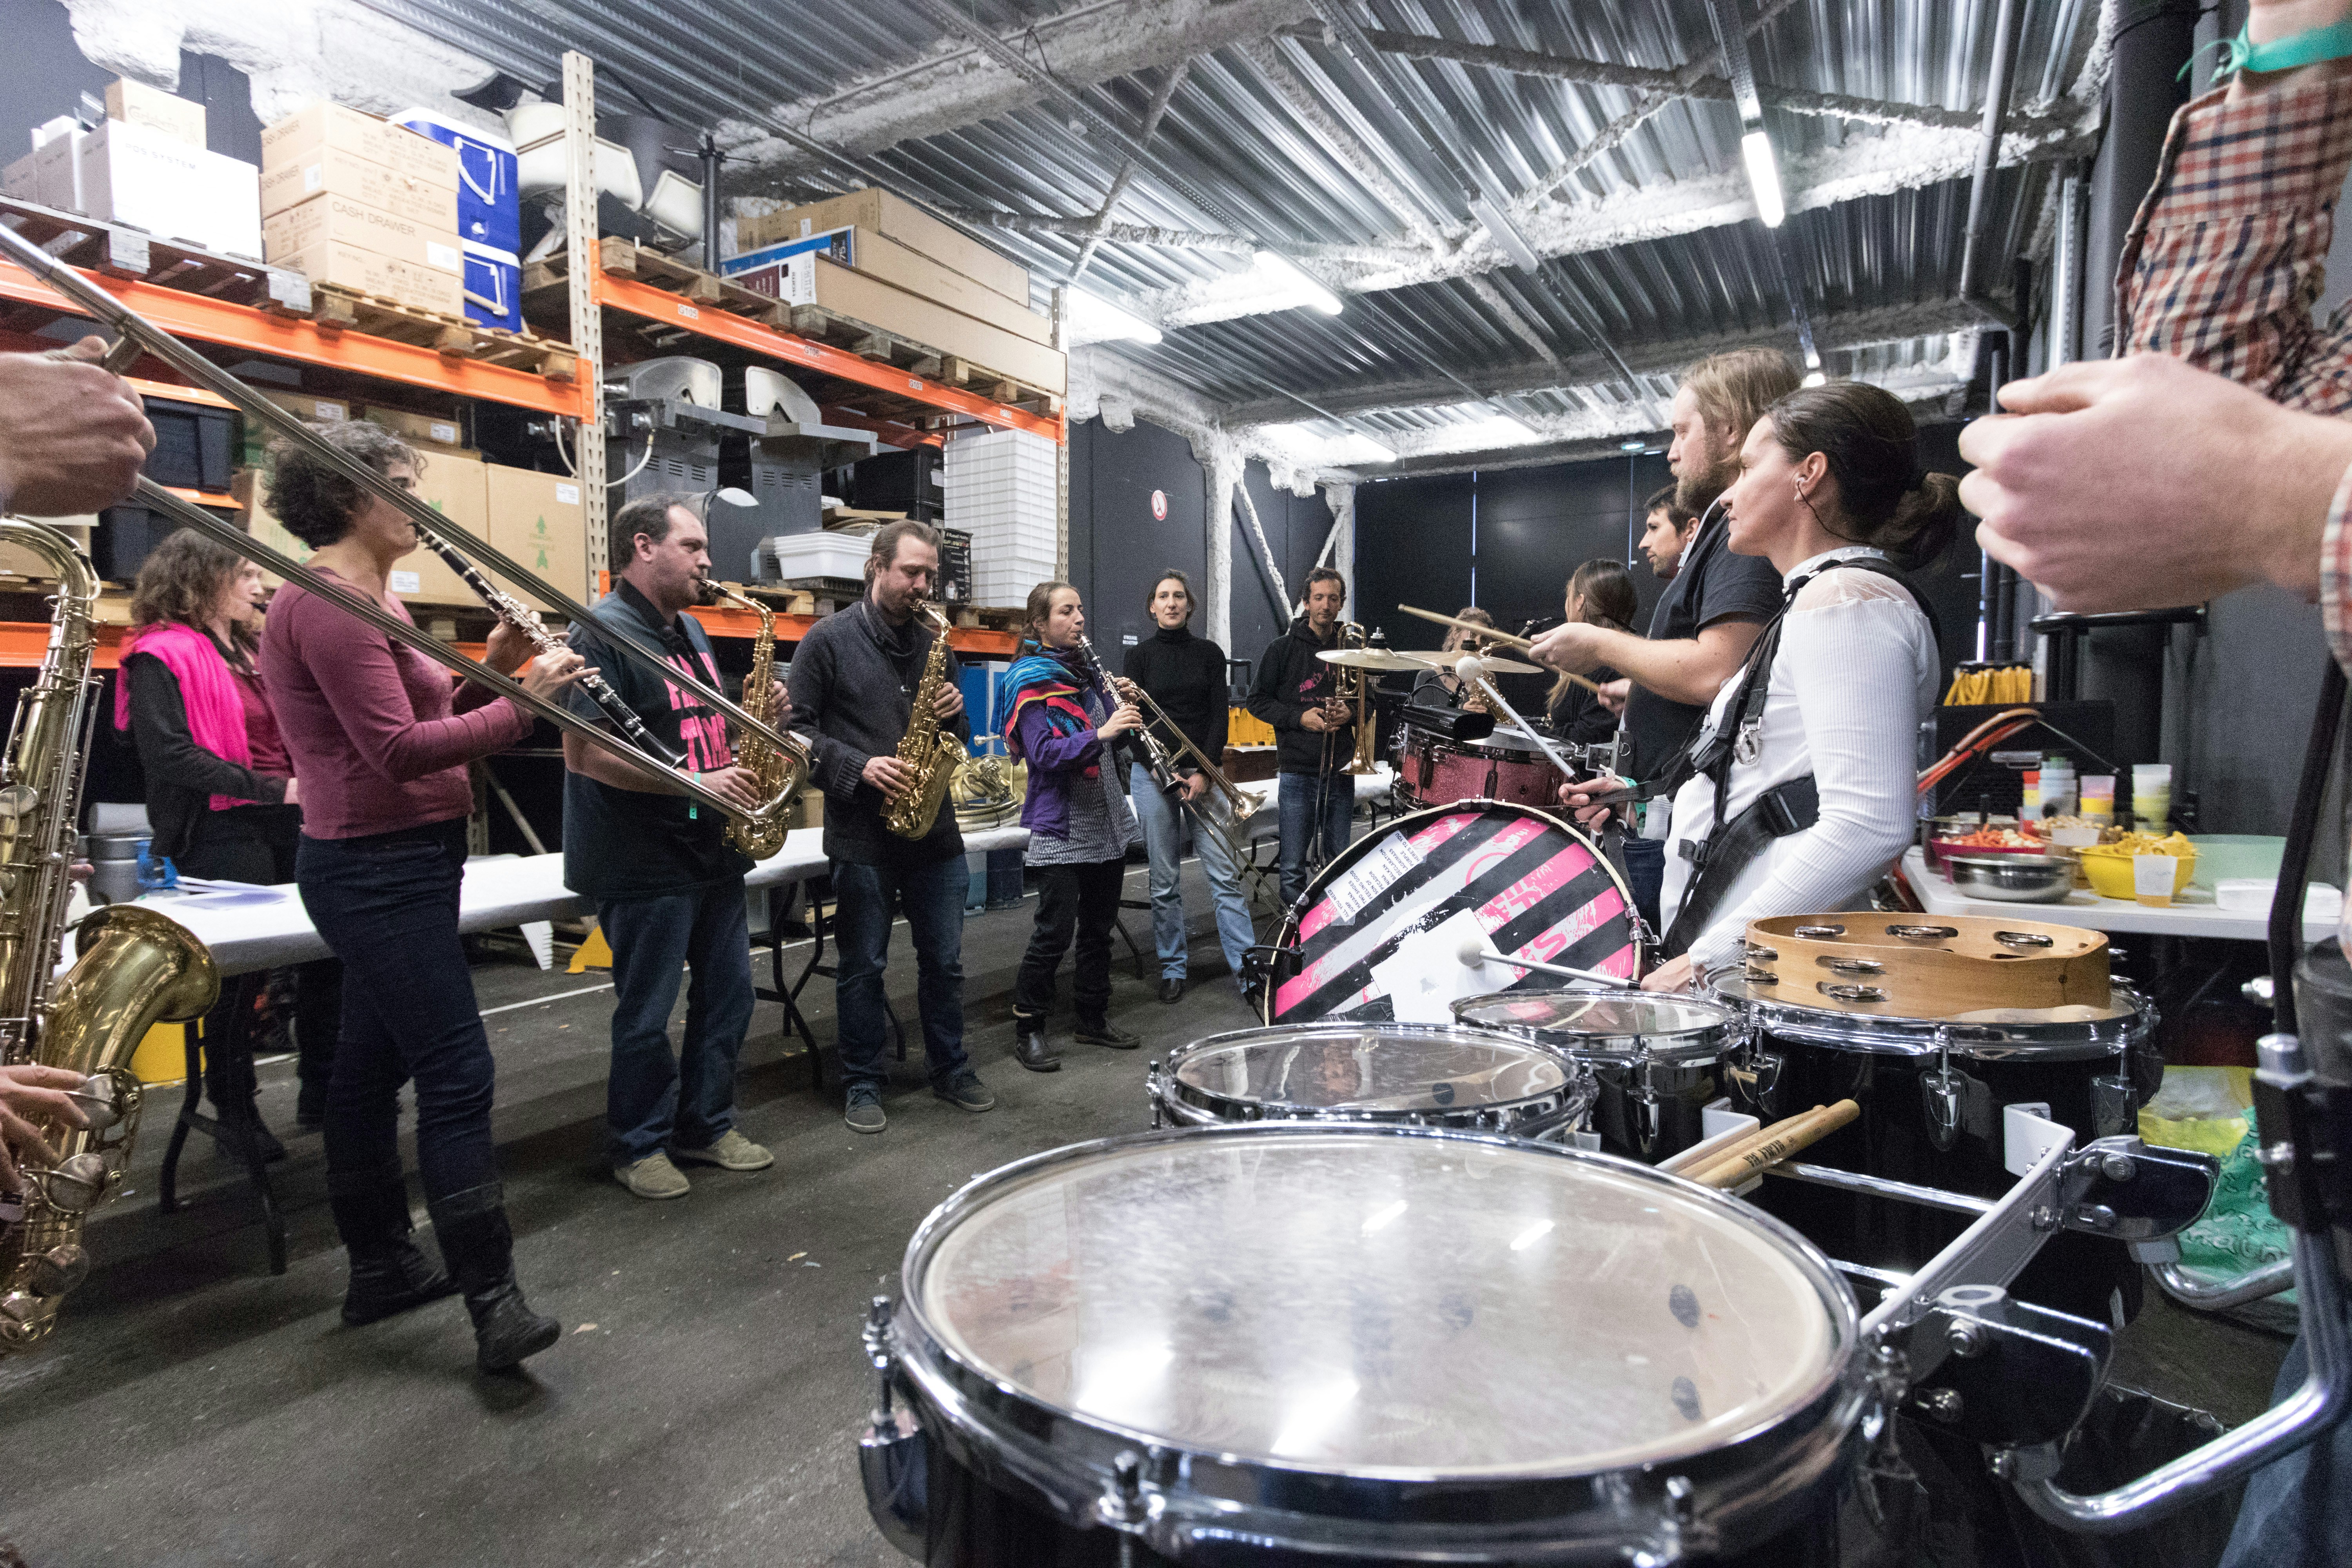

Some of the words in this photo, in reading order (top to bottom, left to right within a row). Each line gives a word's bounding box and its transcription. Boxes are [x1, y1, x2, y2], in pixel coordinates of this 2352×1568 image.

[125, 143, 147, 156] POS
[152, 151, 197, 171] SYSTEM
[332, 201, 365, 221] CASH
[368, 212, 416, 237] DRAWER
[679, 305, 697, 318] G105
[804, 345, 819, 357] G106
[909, 379, 922, 390] G107
[1395, 833, 1403, 842] YOU
[1388, 848, 1408, 871] LAGRIMASS
[1400, 851, 1414, 866] PURPLE
[1408, 848, 1420, 862] HERE'S
[1379, 849, 1402, 876] DECLARATION
[1350, 870, 1360, 882] GOOD
[1382, 864, 1397, 881] BALKAN
[1369, 871, 1384, 890] PECADOR
[1381, 875, 1390, 886] NINA
[1328, 889, 1337, 901] NEED
[1348, 881, 1360, 895] SHOES
[1358, 882, 1373, 900] FEELING
[1370, 886, 1379, 895] SON
[1348, 892, 1361, 909] HAVANA
[1358, 895, 1367, 904] TWO
[1345, 902, 1356, 913] JUMP
